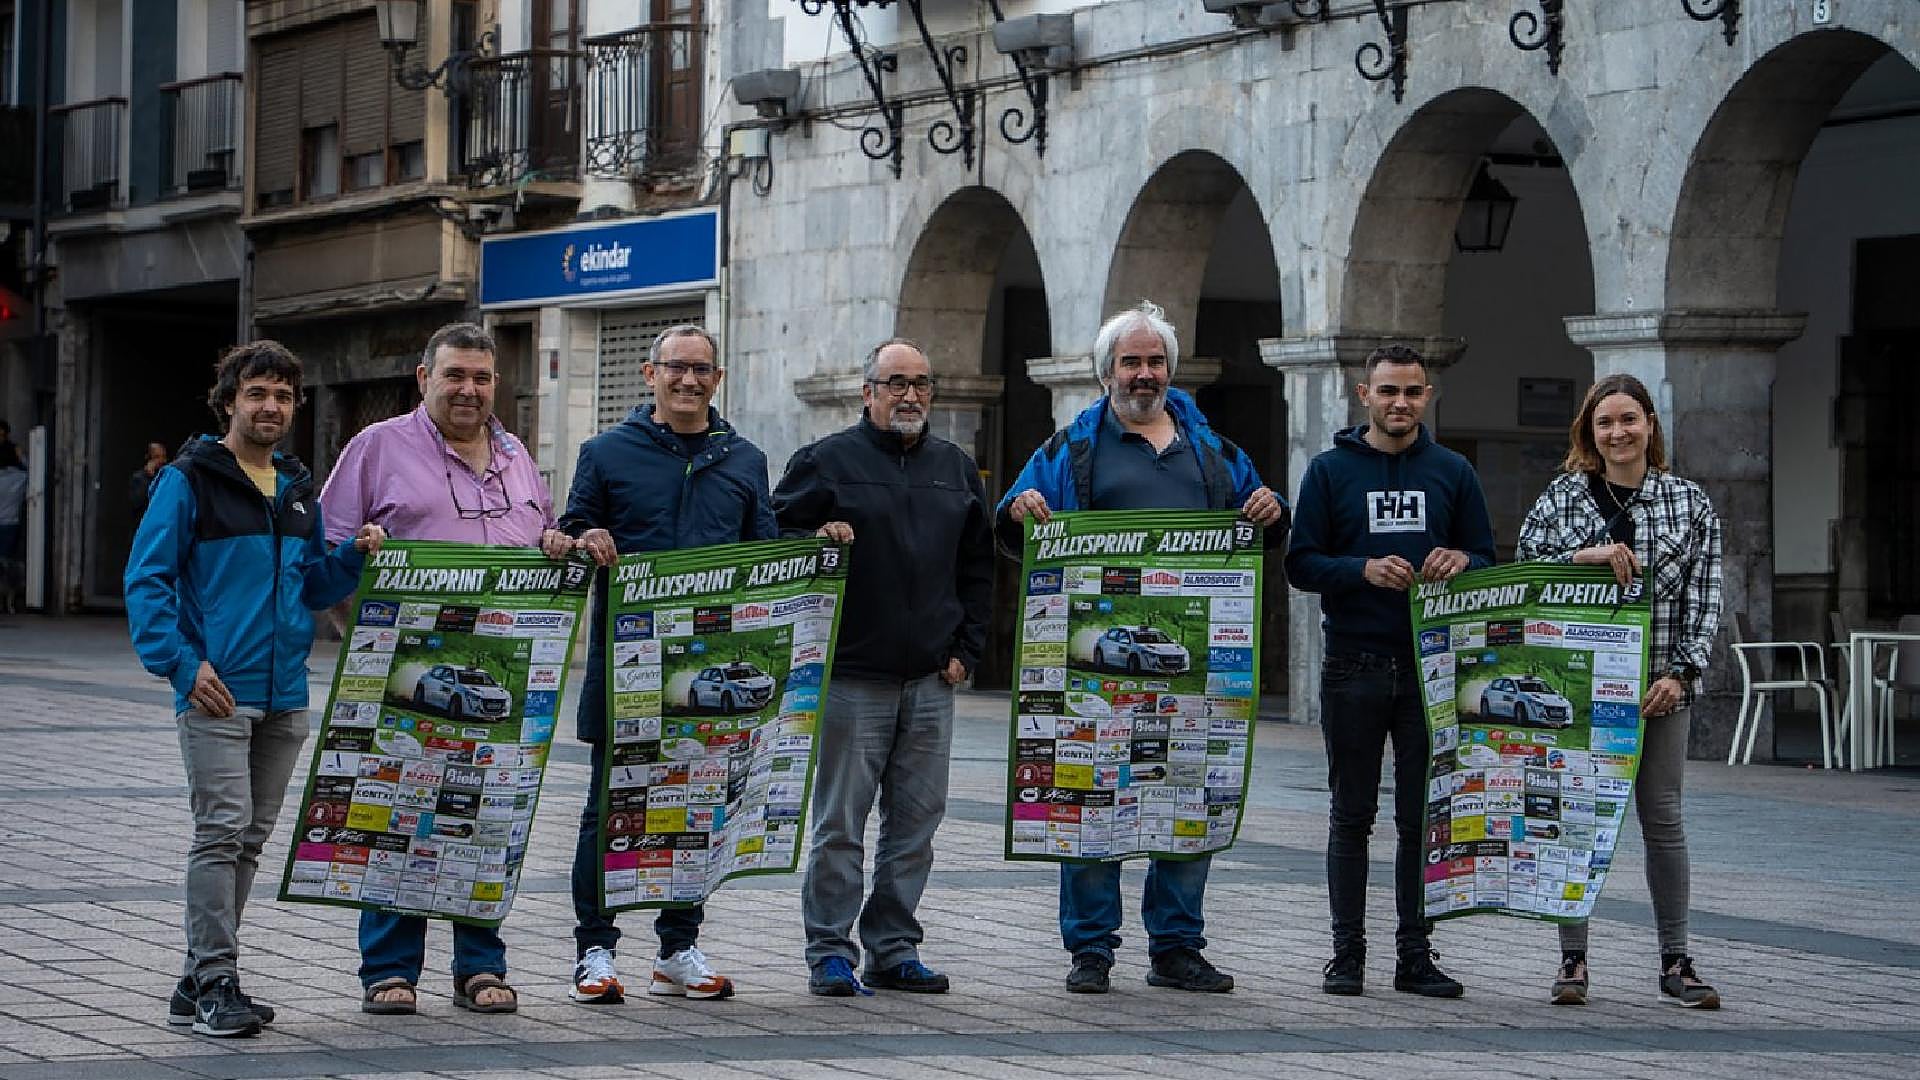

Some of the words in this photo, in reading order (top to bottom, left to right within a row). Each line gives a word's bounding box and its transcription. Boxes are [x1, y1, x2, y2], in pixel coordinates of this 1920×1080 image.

[580, 240, 632, 272] ekindar
[1036, 532, 1148, 560] RALLYSPRINT
[1156, 529, 1233, 552] AZPEITIA
[373, 569, 487, 592] RALLYSPRINT
[495, 569, 562, 591] AZPEITIA
[623, 567, 737, 603] RALLYSPRINT
[746, 555, 817, 586] AZPEITIA
[1183, 575, 1242, 586] ALMOSPORT
[1423, 583, 1529, 619] RALLYSPRINT
[1539, 583, 1619, 605] AZPEITIA
[1565, 628, 1628, 640] ALMOSPORT
